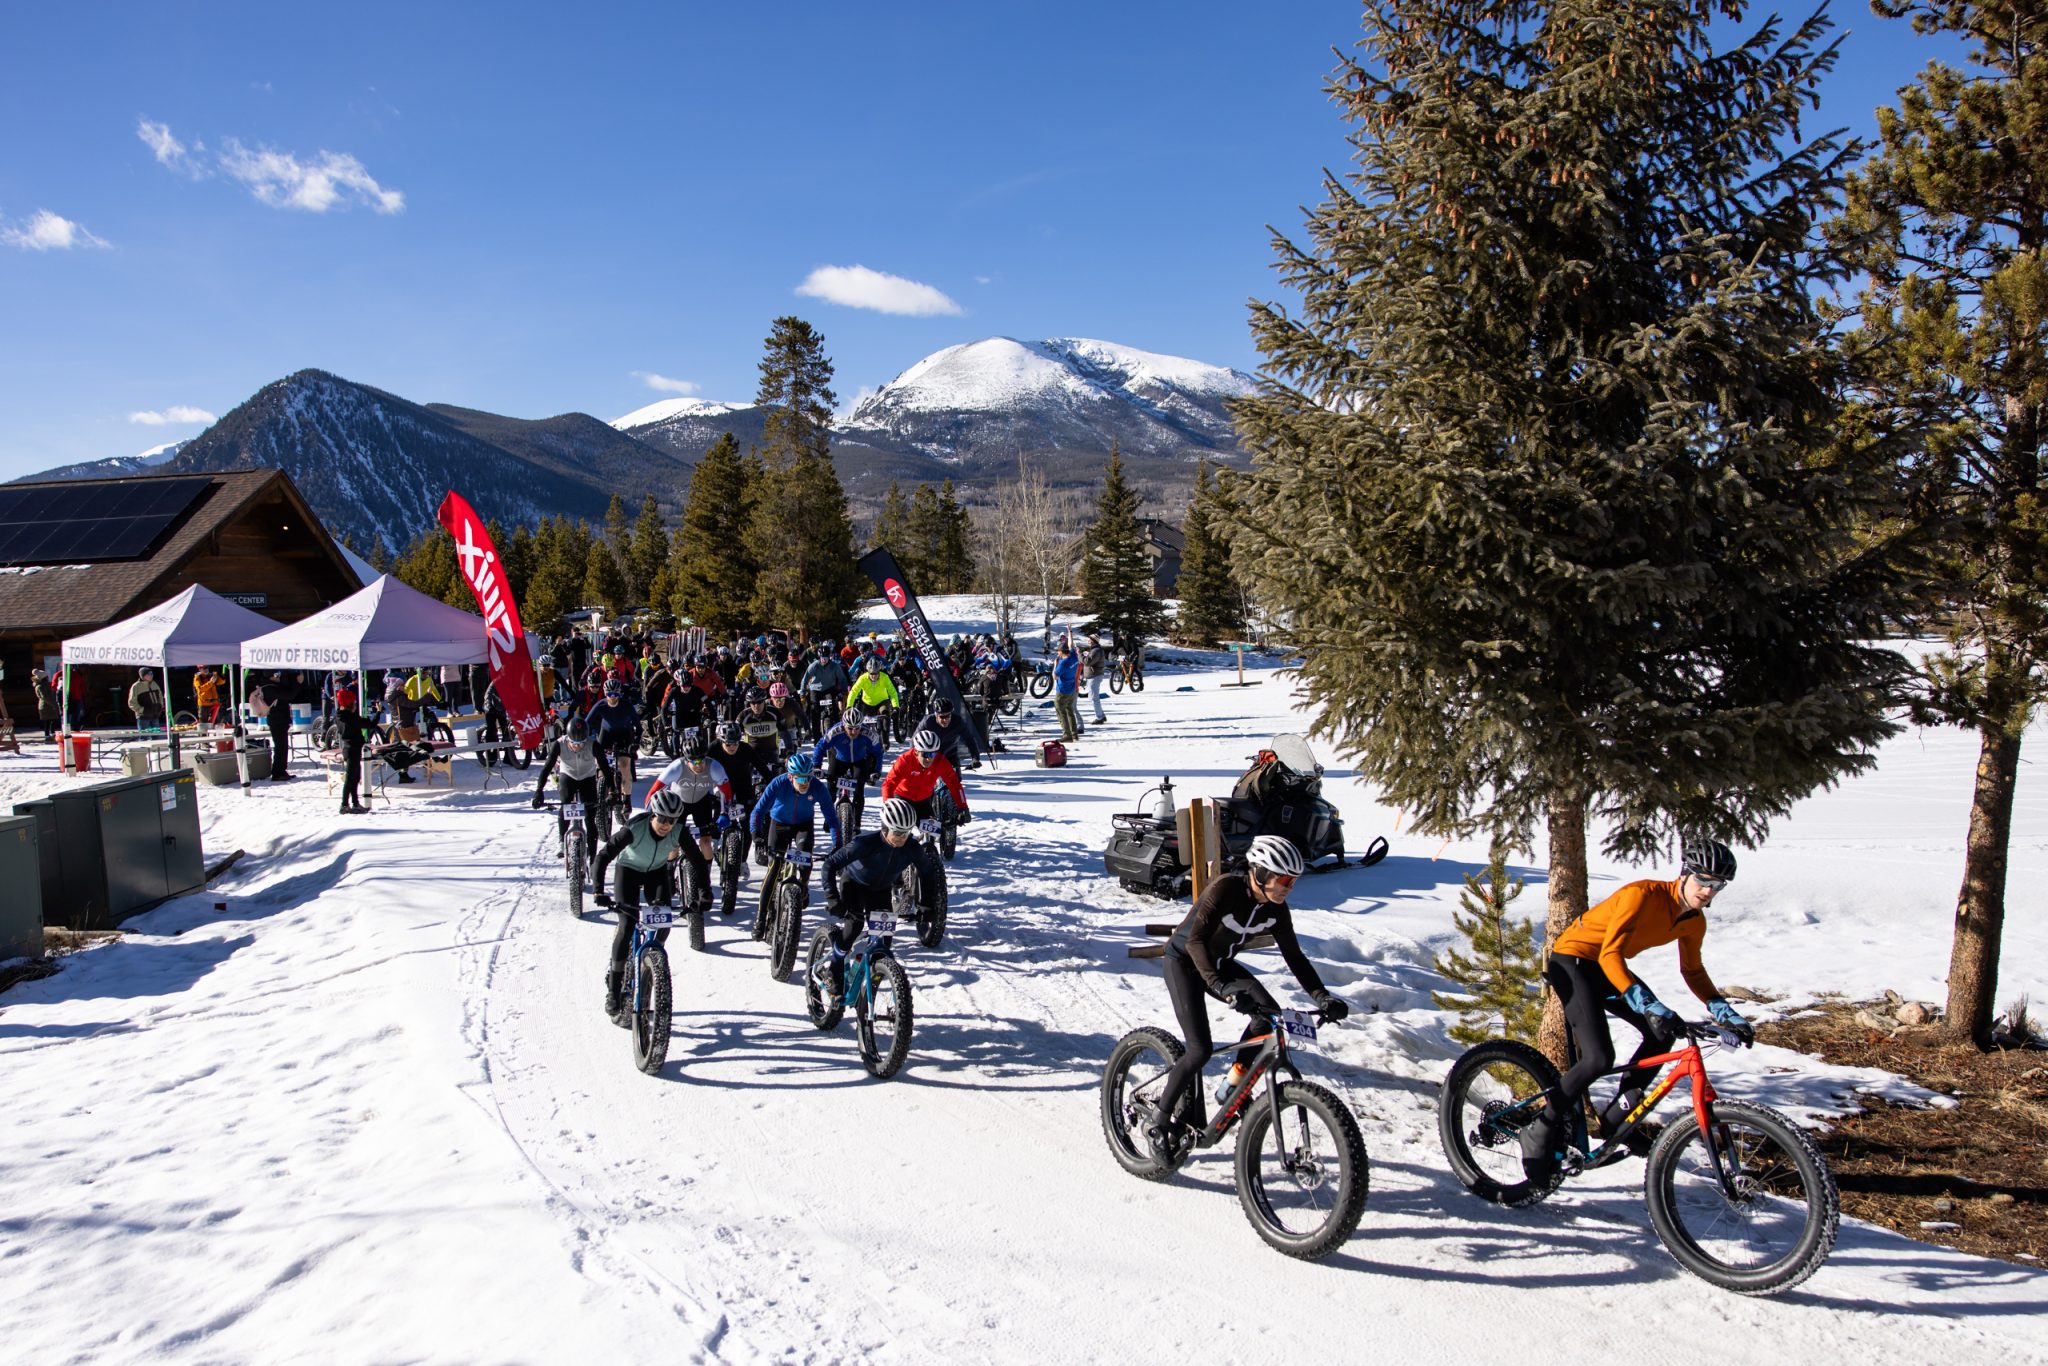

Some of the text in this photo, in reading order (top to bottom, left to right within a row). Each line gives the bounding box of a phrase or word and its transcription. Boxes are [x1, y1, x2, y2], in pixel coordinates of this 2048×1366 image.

[239, 596, 265, 604] CENTER
[69, 646, 154, 661] TOWN OF FRISCO
[250, 648, 349, 664] TOWN OF FRISCO
[751, 724, 770, 734] IOWA
[647, 914, 668, 923] 169
[1291, 1023, 1313, 1038] 204
[1625, 1079, 1671, 1124] TREK
